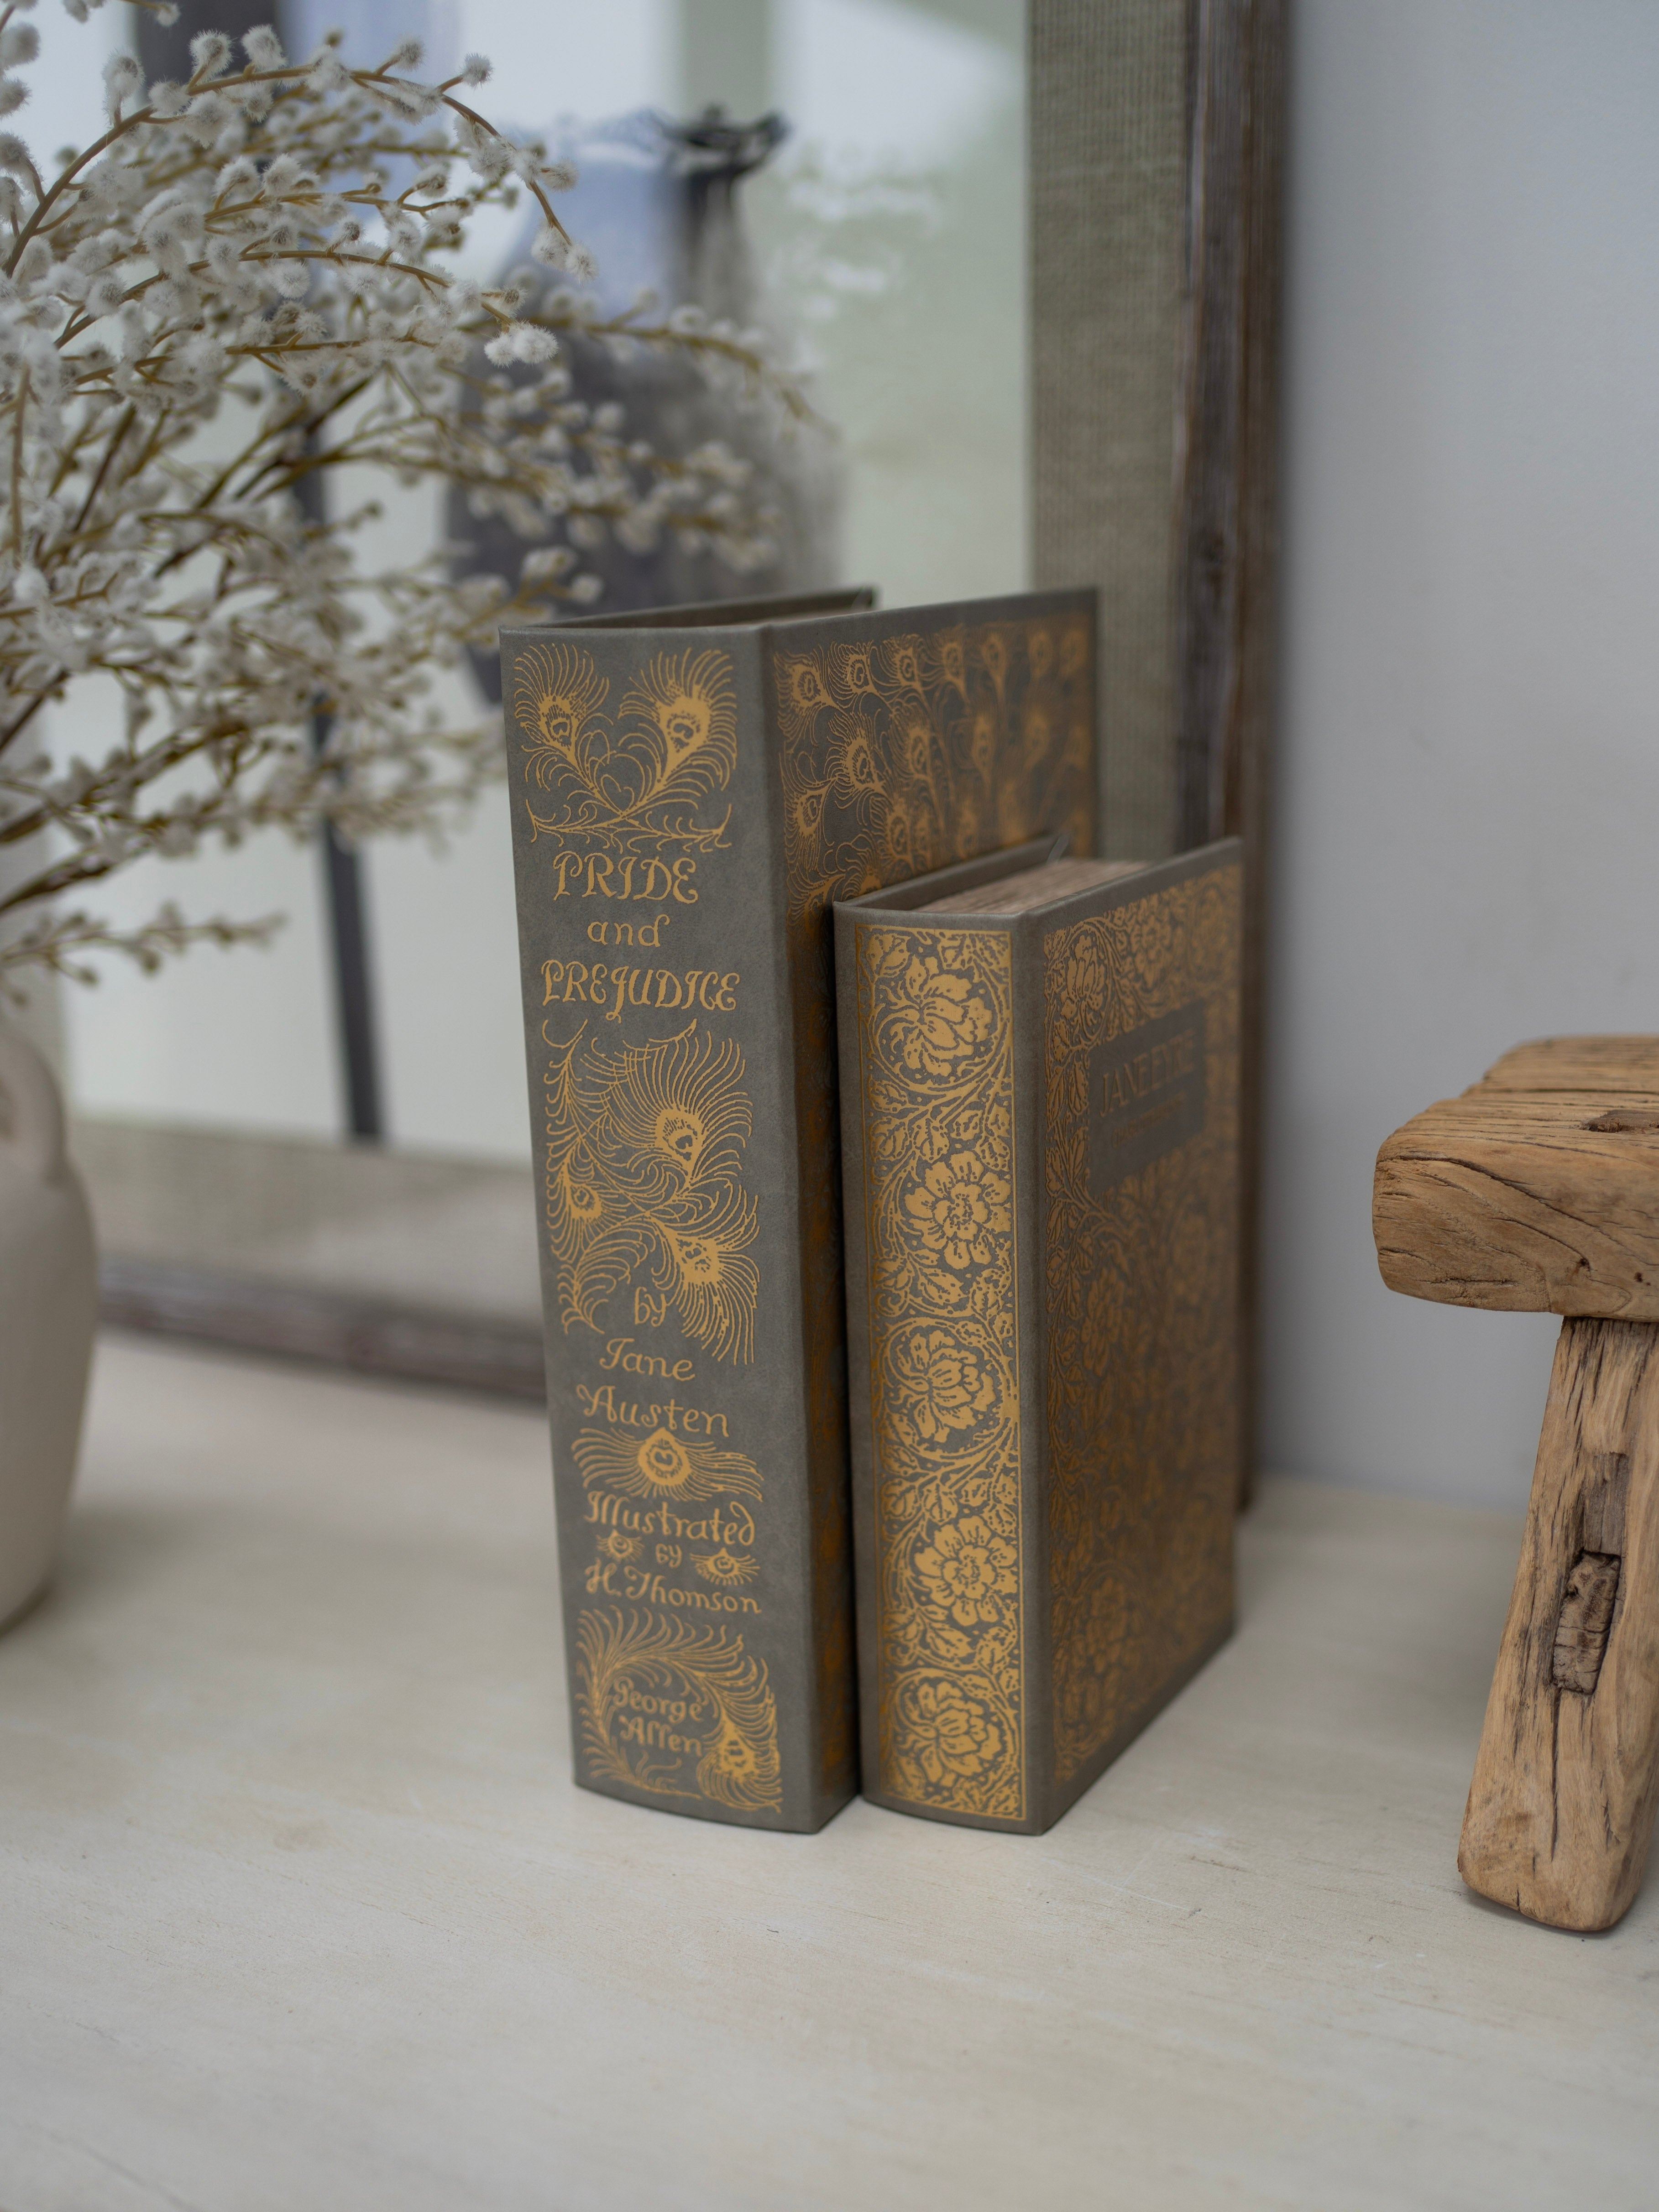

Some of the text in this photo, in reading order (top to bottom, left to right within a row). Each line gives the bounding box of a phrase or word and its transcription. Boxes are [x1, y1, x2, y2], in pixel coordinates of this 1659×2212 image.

[553, 850, 699, 904] PRIDE
[587, 913, 670, 947] and
[541, 960, 740, 1023] PREJUDICE
[1100, 1052, 1151, 1118] JANE
[634, 1286, 667, 1327] by
[599, 1338, 696, 1381] Jane
[576, 1384, 729, 1438] Austen
[584, 1490, 755, 1546] Illustrated
[655, 1543, 682, 1568] by
[624, 1565, 762, 1614] Thomson
[613, 1676, 703, 1723] George
[618, 1715, 702, 1757] Allen
